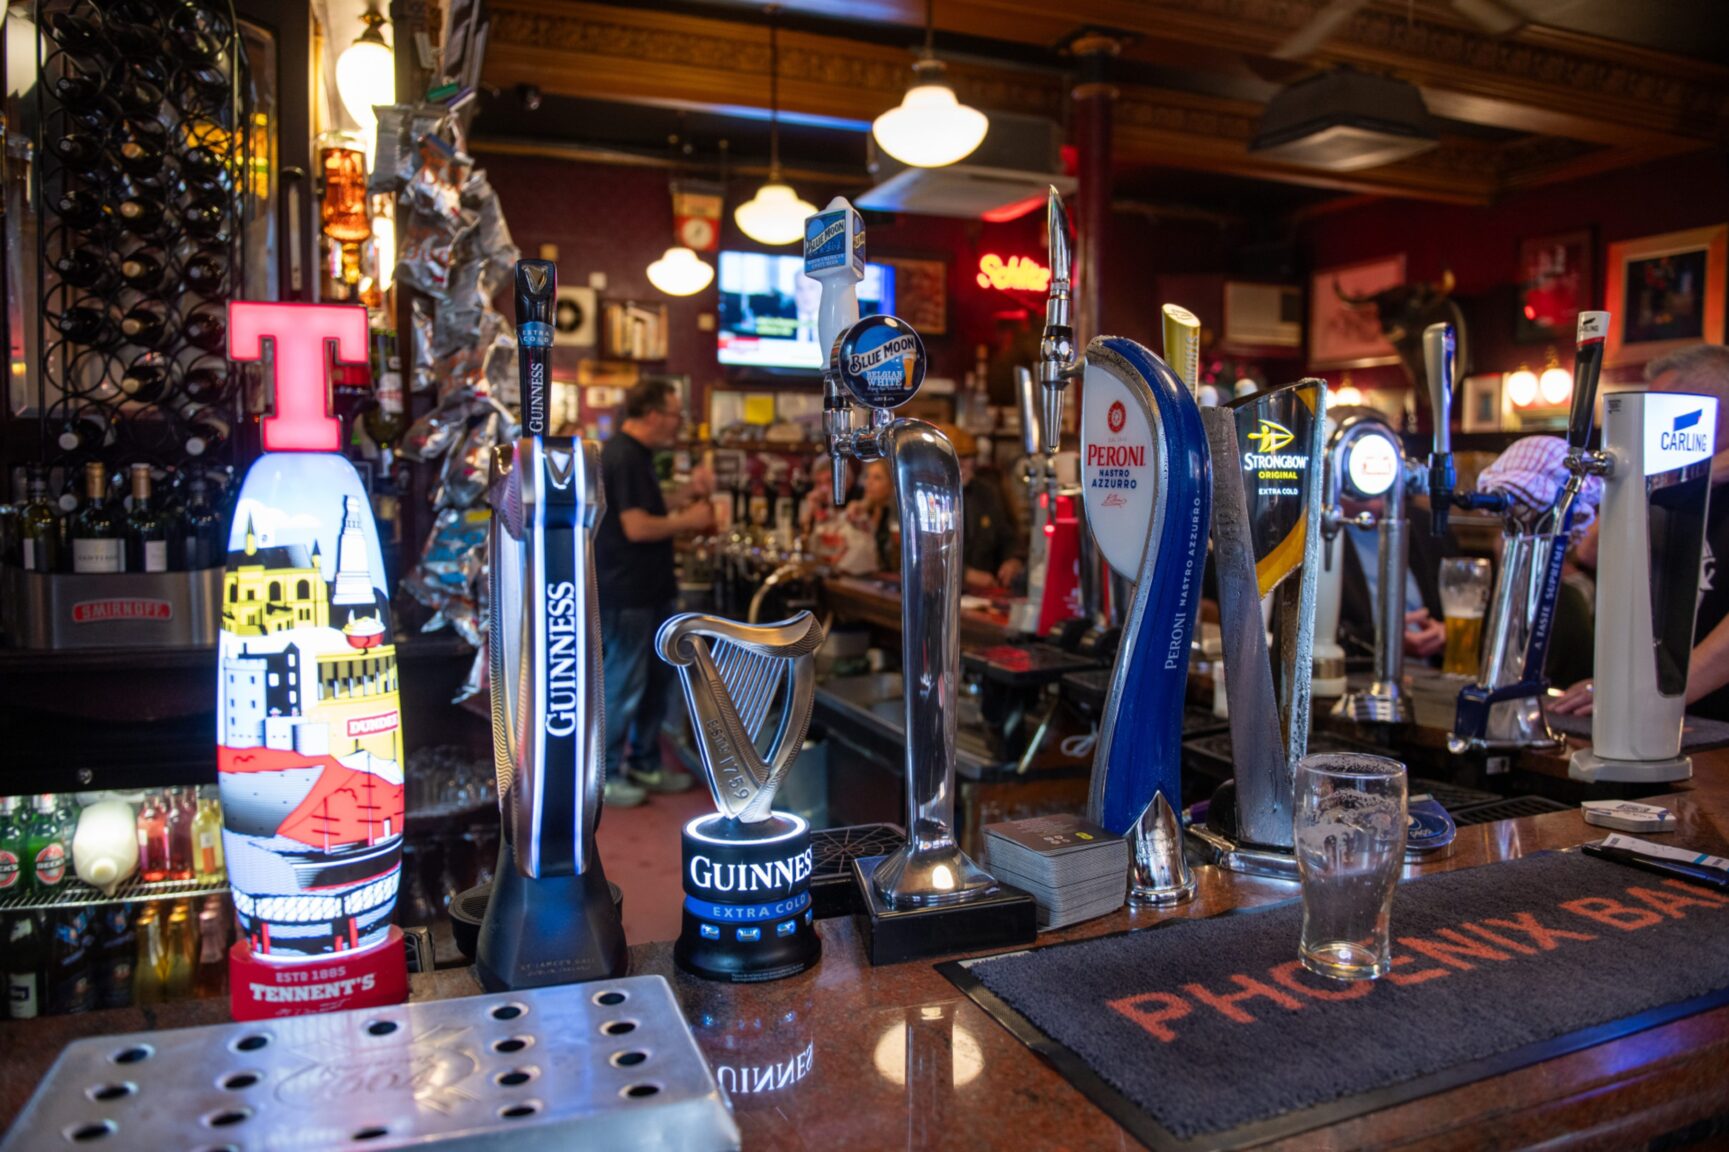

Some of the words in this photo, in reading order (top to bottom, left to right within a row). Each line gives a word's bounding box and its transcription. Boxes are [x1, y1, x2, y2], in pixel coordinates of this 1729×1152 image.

[824, 221, 844, 240] MOON
[522, 328, 550, 337] EXTRA
[849, 350, 881, 375] BLUE
[883, 337, 914, 359] MOON
[229, 300, 370, 453] T
[867, 378, 902, 387] WHITE
[529, 362, 544, 433] GUINNESS
[1661, 431, 1707, 452] CARLING
[1087, 443, 1145, 467] PERONI
[1244, 452, 1307, 471] STRONGBOW
[1091, 479, 1138, 489] AZZURRO
[1098, 469, 1130, 478] NASTRO
[1258, 471, 1298, 480] ORIGINAL
[1258, 487, 1281, 495] EXTRA
[1282, 487, 1299, 495] COLD
[1164, 612, 1187, 670] PERONI
[1179, 560, 1194, 607] NASTRO
[1189, 497, 1200, 557] AZZURRO
[82, 600, 161, 620] SMIRNOFF
[1536, 605, 1550, 637] TASTE
[545, 581, 577, 737] GUINNESS
[719, 755, 750, 800] 1759
[690, 846, 813, 893] GUINNES
[712, 906, 770, 919] EXTRA
[775, 894, 806, 914] COLD
[311, 966, 347, 982] 1885
[249, 972, 376, 1003] TENNENT'S
